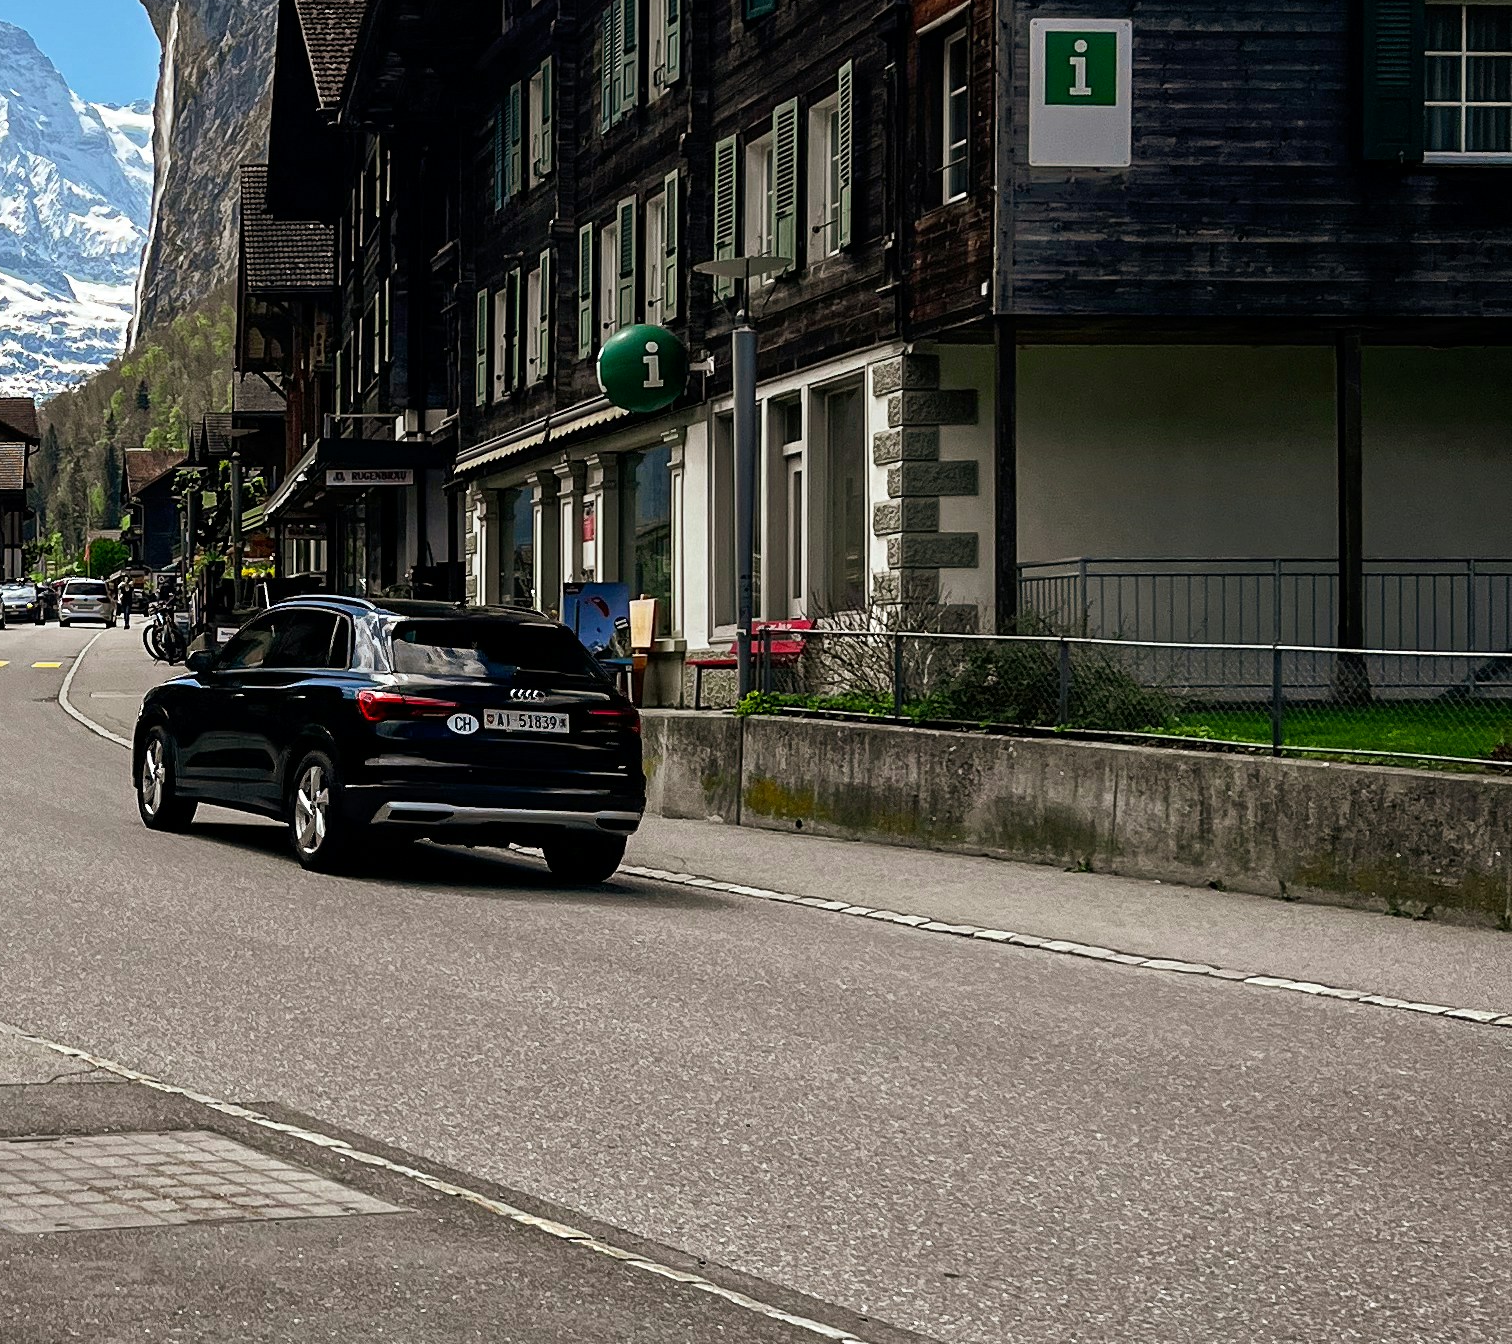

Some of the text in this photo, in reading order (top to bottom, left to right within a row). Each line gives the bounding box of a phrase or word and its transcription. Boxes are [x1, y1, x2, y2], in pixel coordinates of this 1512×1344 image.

[1069, 39, 1092, 96] i
[642, 341, 664, 388] i
[454, 716, 472, 732] CH
